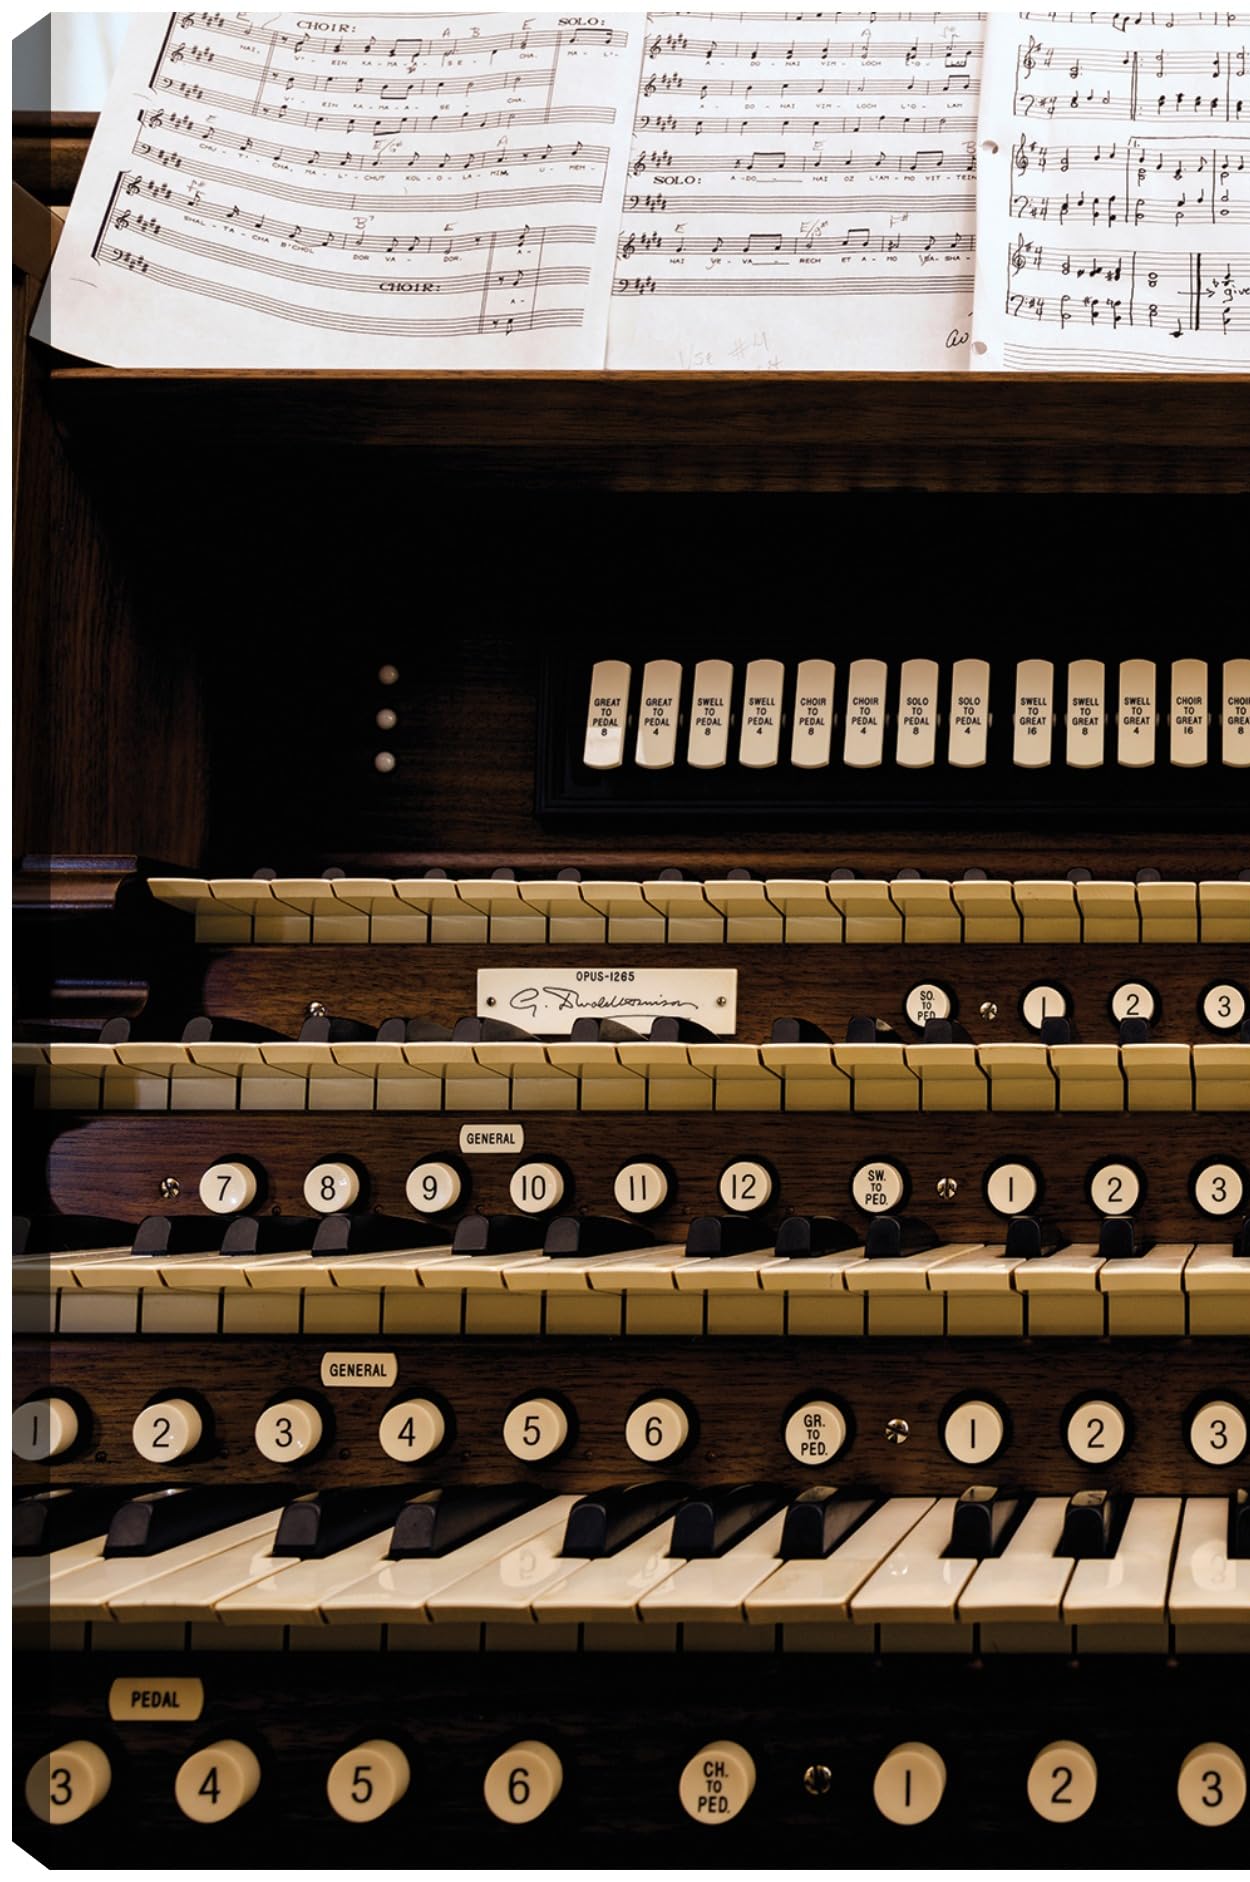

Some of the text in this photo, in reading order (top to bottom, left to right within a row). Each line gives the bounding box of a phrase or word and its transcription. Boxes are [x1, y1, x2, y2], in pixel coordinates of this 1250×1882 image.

[296, 20, 358, 34] CHOIR:
[558, 17, 606, 26] SOLO:
[653, 176, 702, 185] SOLO:
[379, 282, 441, 292] CHOIR:
[1222, 285, 1250, 303] give
[594, 698, 620, 706] GREAT
[957, 697, 981, 706] SOLO
[601, 708, 612, 716] TO
[963, 708, 975, 716] TO
[1028, 707, 1038, 715] TO
[1236, 707, 1246, 715] TO
[593, 718, 617, 726] PEDAL
[1020, 717, 1046, 725] GREAT
[601, 728, 607, 736] 8
[1028, 727, 1037, 735] 16
[576, 971, 635, 982] OPUS-1265
[920, 991, 934, 1001] SO.
[922, 1001, 932, 1010] TO
[1218, 996, 1230, 1017] 3
[467, 1133, 515, 1144] GENERAL
[868, 1170, 885, 1181] SW.
[217, 1176, 231, 1200] 7
[423, 1176, 437, 1200] 9
[518, 1174, 548, 1202] 10
[733, 1174, 755, 1199] 12
[871, 1183, 882, 1192] TO
[865, 1193, 886, 1205] PED.
[330, 1364, 386, 1377] GENERAL
[804, 1414, 825, 1427] GR.
[153, 1418, 170, 1447] 2
[523, 1416, 540, 1445] 5
[807, 1429, 820, 1440] TO
[1211, 1420, 1227, 1449] 3
[801, 1442, 831, 1458] PED.
[132, 1691, 179, 1707] PEDAL
[704, 1761, 728, 1777] CH.
[198, 1767, 220, 1804] 4
[509, 1768, 529, 1804] 6
[706, 1780, 722, 1793] TO
[1051, 1766, 1072, 1803] 2
[698, 1796, 729, 1813] PED.
